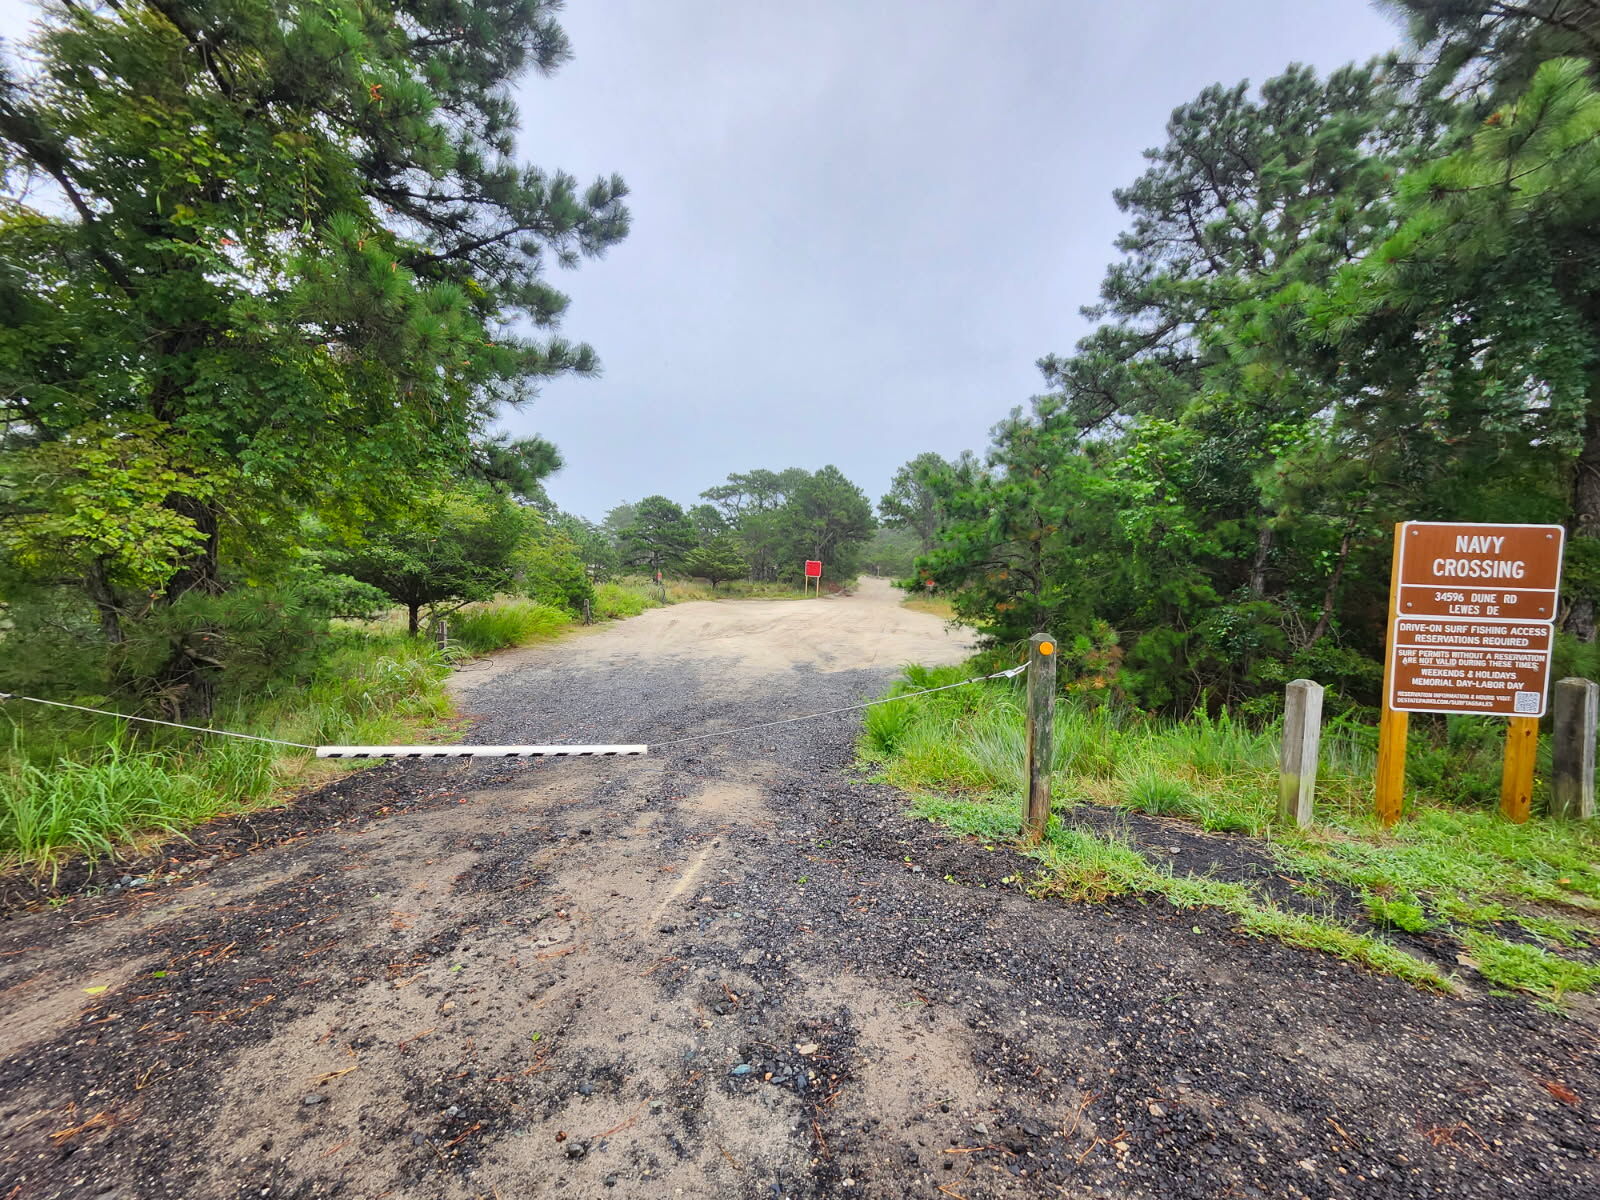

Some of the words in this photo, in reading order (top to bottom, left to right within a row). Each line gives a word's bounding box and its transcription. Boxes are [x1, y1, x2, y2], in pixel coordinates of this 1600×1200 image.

[1455, 535, 1505, 554] NAVY
[1432, 558, 1525, 579] CROSSING
[1434, 592, 1464, 602] 34596
[1471, 593, 1496, 603] DUNE
[1503, 594, 1518, 604] RD
[1449, 605, 1480, 615] LEWES
[1487, 606, 1499, 615] DE
[1400, 623, 1442, 632] DRIVE-ON
[1444, 625, 1467, 633] SURF
[1471, 626, 1507, 635] FISHING
[1512, 627, 1547, 636] ACCESS
[1415, 635, 1480, 644] RESERVATIONS
[1482, 637, 1528, 646] REQUIRED
[1418, 650, 1449, 658] PERMITS
[1494, 654, 1545, 662] RESERVATION
[1436, 658, 1456, 666] VALID
[1458, 659, 1486, 667] DURING
[1421, 668, 1464, 677] WEEKENDS
[1475, 671, 1517, 679] HOLIDAYS
[1412, 678, 1452, 687] MEMORIAL
[1456, 680, 1505, 688] DAY-LABOR
[1507, 682, 1524, 690] DAY
